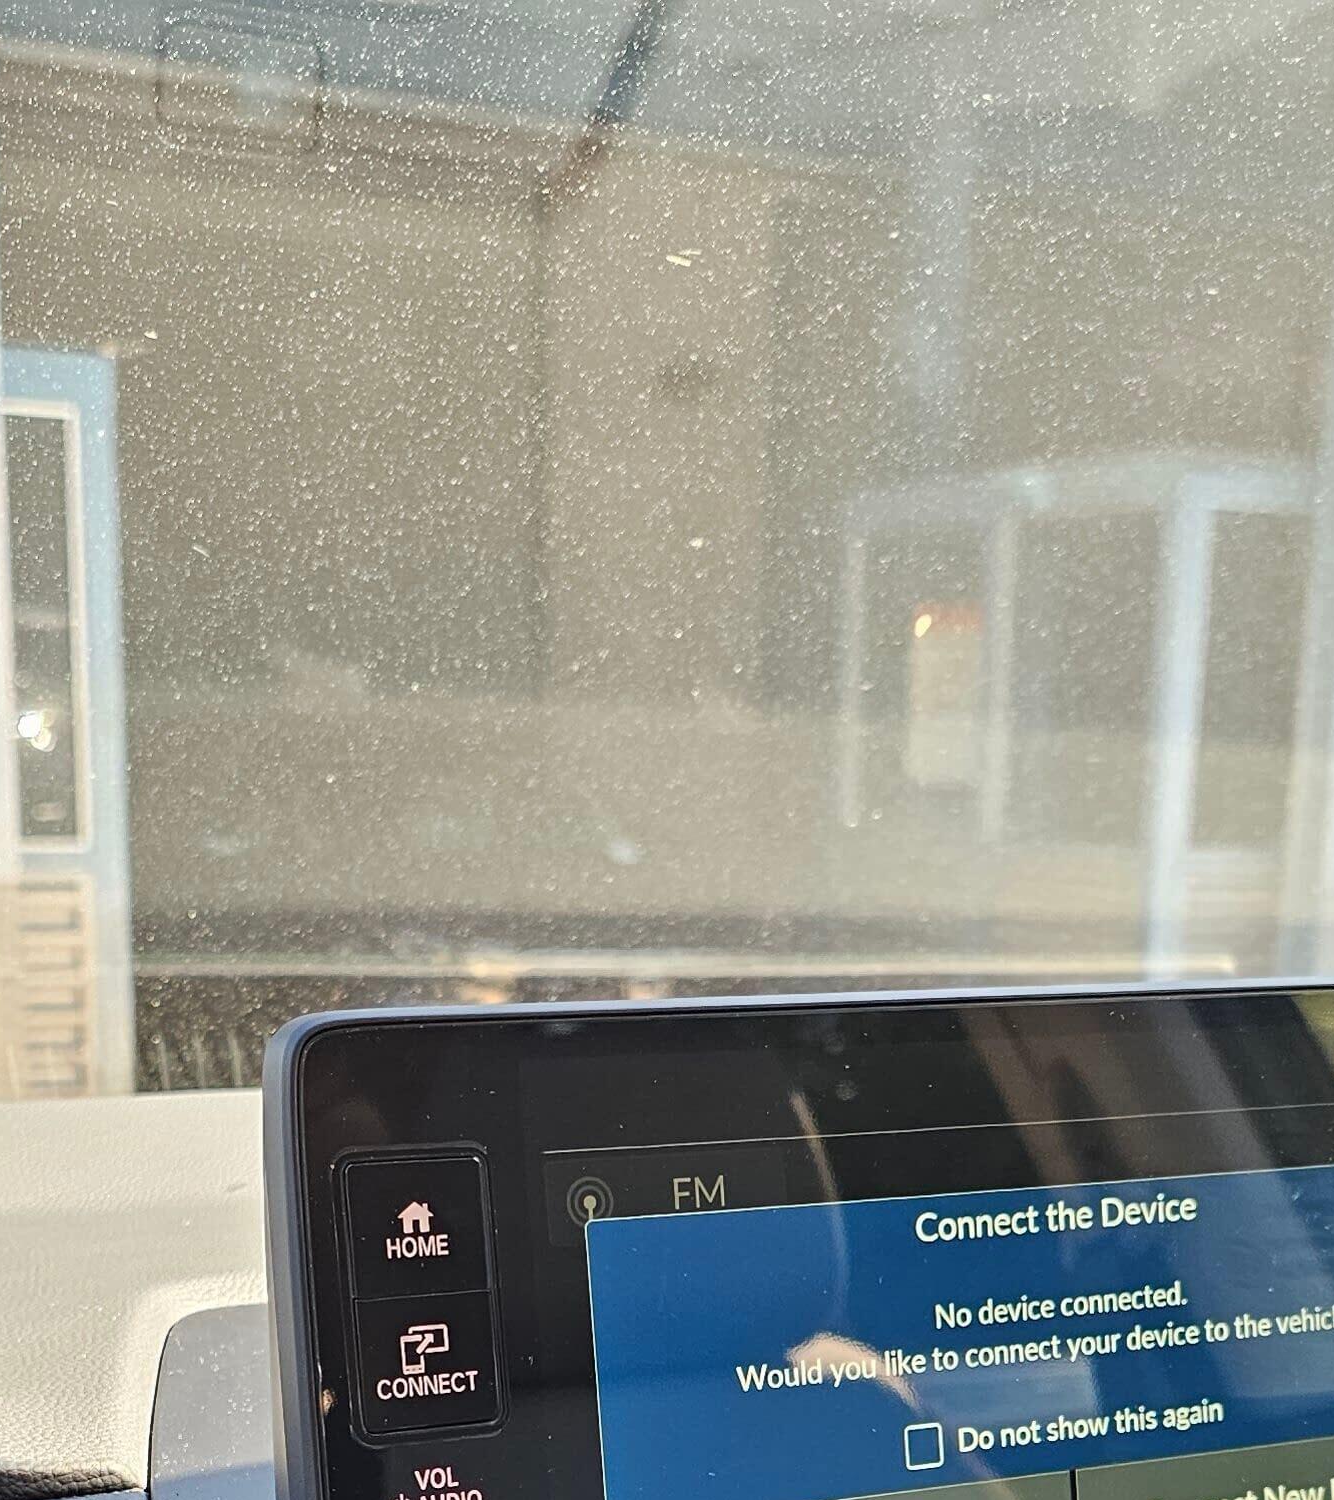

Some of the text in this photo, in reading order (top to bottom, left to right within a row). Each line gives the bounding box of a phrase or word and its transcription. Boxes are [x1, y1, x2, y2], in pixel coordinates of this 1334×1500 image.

[672, 1175, 726, 1210] FM
[914, 1193, 1198, 1244] Connect the Device
[385, 1233, 450, 1260] HOME
[934, 1281, 1188, 1330] No device connected.
[735, 1358, 823, 1393] Would
[831, 1361, 878, 1386] you
[884, 1350, 926, 1376] like
[932, 1348, 959, 1372] to
[964, 1337, 1062, 1368] connect
[1066, 1334, 1122, 1364] your
[1126, 1324, 1201, 1352] device
[1204, 1320, 1230, 1343] to
[1233, 1314, 1273, 1339] the
[376, 1370, 479, 1400] CONNECT
[957, 1399, 1225, 1453] Do not show this again
[414, 1466, 460, 1490] VOL
